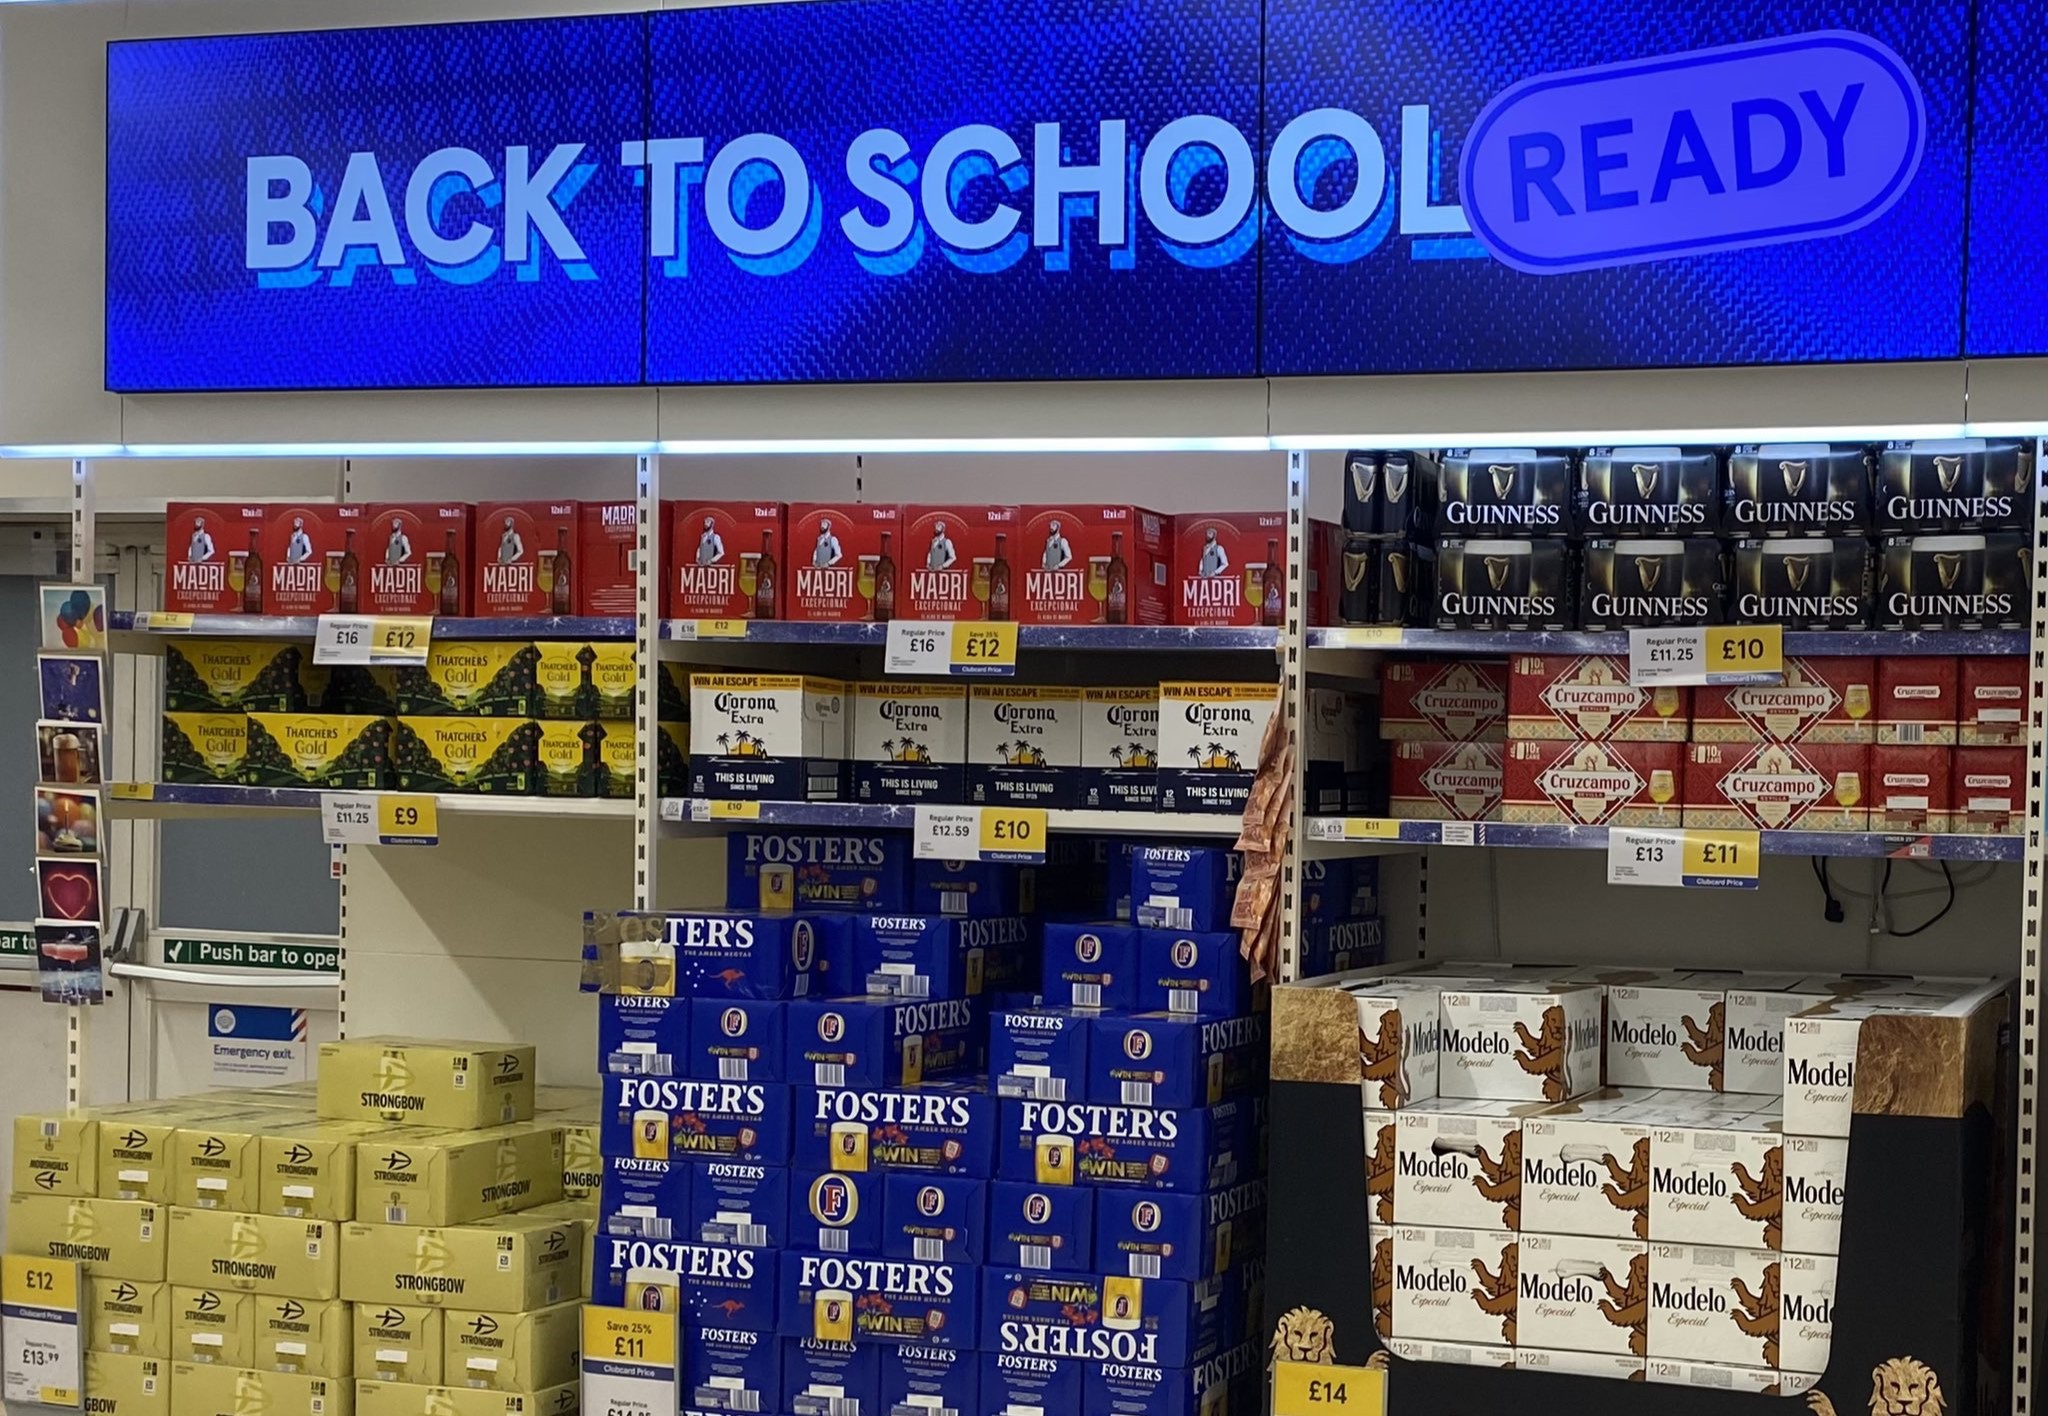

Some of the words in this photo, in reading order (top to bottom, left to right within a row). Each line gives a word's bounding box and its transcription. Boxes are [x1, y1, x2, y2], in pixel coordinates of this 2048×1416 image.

[1508, 82, 1866, 222] READY
[246, 143, 588, 268] BACK
[622, 132, 810, 258] TO
[840, 105, 1470, 254] SCHOOL
[602, 506, 636, 526] MADR
[1447, 502, 1560, 524] GUINNESS
[1589, 502, 1705, 524] GUINNESS
[1735, 500, 1855, 523] GUINNESS
[1888, 496, 2012, 519] GUINNESS
[1442, 592, 1555, 616] GUINNESS
[1592, 593, 1708, 617] GUINNESS
[1740, 594, 1858, 617] GUINNESS
[682, 625, 694, 633] £16
[715, 621, 728, 629] £12
[336, 632, 358, 644] £16
[386, 632, 415, 648] £12
[910, 638, 934, 652] £16
[1647, 638, 1675, 646] Regular
[966, 638, 1000, 657] £12
[1650, 648, 1694, 661] £11.25
[1722, 639, 1764, 660] £10
[202, 654, 250, 665] THATCHERS
[436, 655, 488, 666] THATCHERS
[211, 666, 241, 682] Gold
[445, 669, 478, 684] Gold
[693, 676, 710, 685] WIN
[712, 676, 724, 686] AN
[725, 677, 758, 687] ESCAPE
[974, 687, 992, 696] WIN
[992, 688, 1006, 697] AN
[1007, 688, 1038, 698] ESCAPE
[1164, 686, 1182, 696] WIN
[1182, 686, 1197, 696] AN
[1198, 687, 1232, 697] ESCAPE
[1555, 688, 1636, 706] Cruzcampo
[1741, 690, 1826, 709] Cruzcampo
[714, 692, 778, 712] Corona
[879, 700, 942, 720] Corona
[1425, 694, 1498, 711] Cruzcampo
[731, 711, 764, 724] Extra
[994, 703, 1058, 723] Corona
[1107, 705, 1158, 726] Coron
[1185, 703, 1254, 724] Corona
[198, 725, 246, 738] THATCHERS
[285, 726, 338, 739] THATCHERS
[896, 718, 928, 732] Extra
[1010, 721, 1044, 735] Extra
[1202, 722, 1238, 736] Extra
[436, 730, 487, 742] THATCHERS
[206, 738, 236, 753] Gold
[294, 740, 328, 755] Gold
[444, 744, 476, 758] Gold
[715, 772, 734, 783] THIS
[736, 773, 744, 784] IS
[745, 773, 774, 784] LIVING
[1550, 773, 1630, 792] Cruzcampo
[1887, 776, 1926, 786] Cruzcampo
[1968, 776, 2008, 786] Cruzcampo
[995, 782, 1014, 791] THIS
[1016, 782, 1024, 792] IS
[1026, 783, 1054, 793] LIVING
[1186, 786, 1206, 796] THIS
[1209, 788, 1216, 798] IS
[1218, 788, 1248, 799] LIVING
[1732, 778, 1816, 796] Cruzcampo
[334, 802, 354, 810] Regular
[337, 812, 369, 824] £11.25
[395, 807, 418, 825] £9
[930, 814, 954, 822] Regular
[932, 825, 970, 836] £12.59
[994, 820, 1030, 839] £10
[1366, 822, 1379, 830] £11
[1626, 836, 1654, 845] Regular
[1656, 837, 1676, 845] Price
[745, 835, 884, 864] FOSTER'S
[1636, 847, 1664, 862] £13
[1703, 843, 1738, 864] £11
[1696, 878, 1725, 886] Clubcard
[871, 917, 926, 930] FOSTER'S
[0, 936, 18, 949] ar
[22, 934, 37, 950] to
[200, 943, 244, 962] Push
[249, 947, 276, 962] bar
[282, 949, 298, 964] to
[1004, 1014, 1064, 1031] FOSTER'S
[1442, 1028, 1510, 1054] Modelo
[1611, 1021, 1677, 1046] Modelo
[213, 1044, 270, 1061] Emergency
[273, 1048, 295, 1060] exit.
[1624, 1046, 1662, 1059] Especial
[1457, 1058, 1494, 1069] Especial
[1788, 1059, 1854, 1087] Model
[361, 1092, 424, 1111] STRONGBOW
[619, 1079, 764, 1115] FOSTER'S
[1804, 1088, 1848, 1102] Especial
[816, 1090, 970, 1127] FOSTER'S
[1020, 1102, 1178, 1140] FOSTER'S
[614, 1157, 670, 1173] FOSTER'S
[708, 1164, 764, 1179] FOSTER'S
[1089, 1161, 1126, 1178] WIN
[1399, 1152, 1469, 1180] Modelo
[1524, 1159, 1598, 1188] Modelo
[374, 1170, 418, 1183] STRONGBOW
[1654, 1167, 1726, 1197] Modelo
[1413, 1180, 1452, 1194] Especial
[1539, 1188, 1580, 1202] Especial
[49, 1242, 110, 1262] STRONGBOW
[611, 1240, 754, 1280] FOSTER'S
[212, 1259, 276, 1280] STRONGBOW
[800, 1257, 954, 1296] FOSTER'S
[26, 1270, 54, 1290] £12
[395, 1274, 465, 1294] STRONGBOW
[1396, 1265, 1467, 1293] Modelo
[1520, 1273, 1593, 1303] Modelo
[185, 1310, 226, 1324] STRONGBOW
[868, 1315, 903, 1332] WIN
[368, 1328, 410, 1340] STRONGBOW
[607, 1320, 629, 1332] Save
[632, 1323, 652, 1334] 25%
[701, 1328, 758, 1344] FOSTER'S
[615, 1336, 644, 1358] £11
[22, 1349, 59, 1366] £13.99
[998, 1354, 1058, 1373] FOSTER'S
[604, 1364, 636, 1374] Clubcard
[637, 1367, 655, 1377] Price
[1102, 1364, 1162, 1382] FOSTER'S
[1309, 1381, 1348, 1404] £14
[610, 1398, 631, 1407] Regular
[632, 1400, 648, 1408] Price
